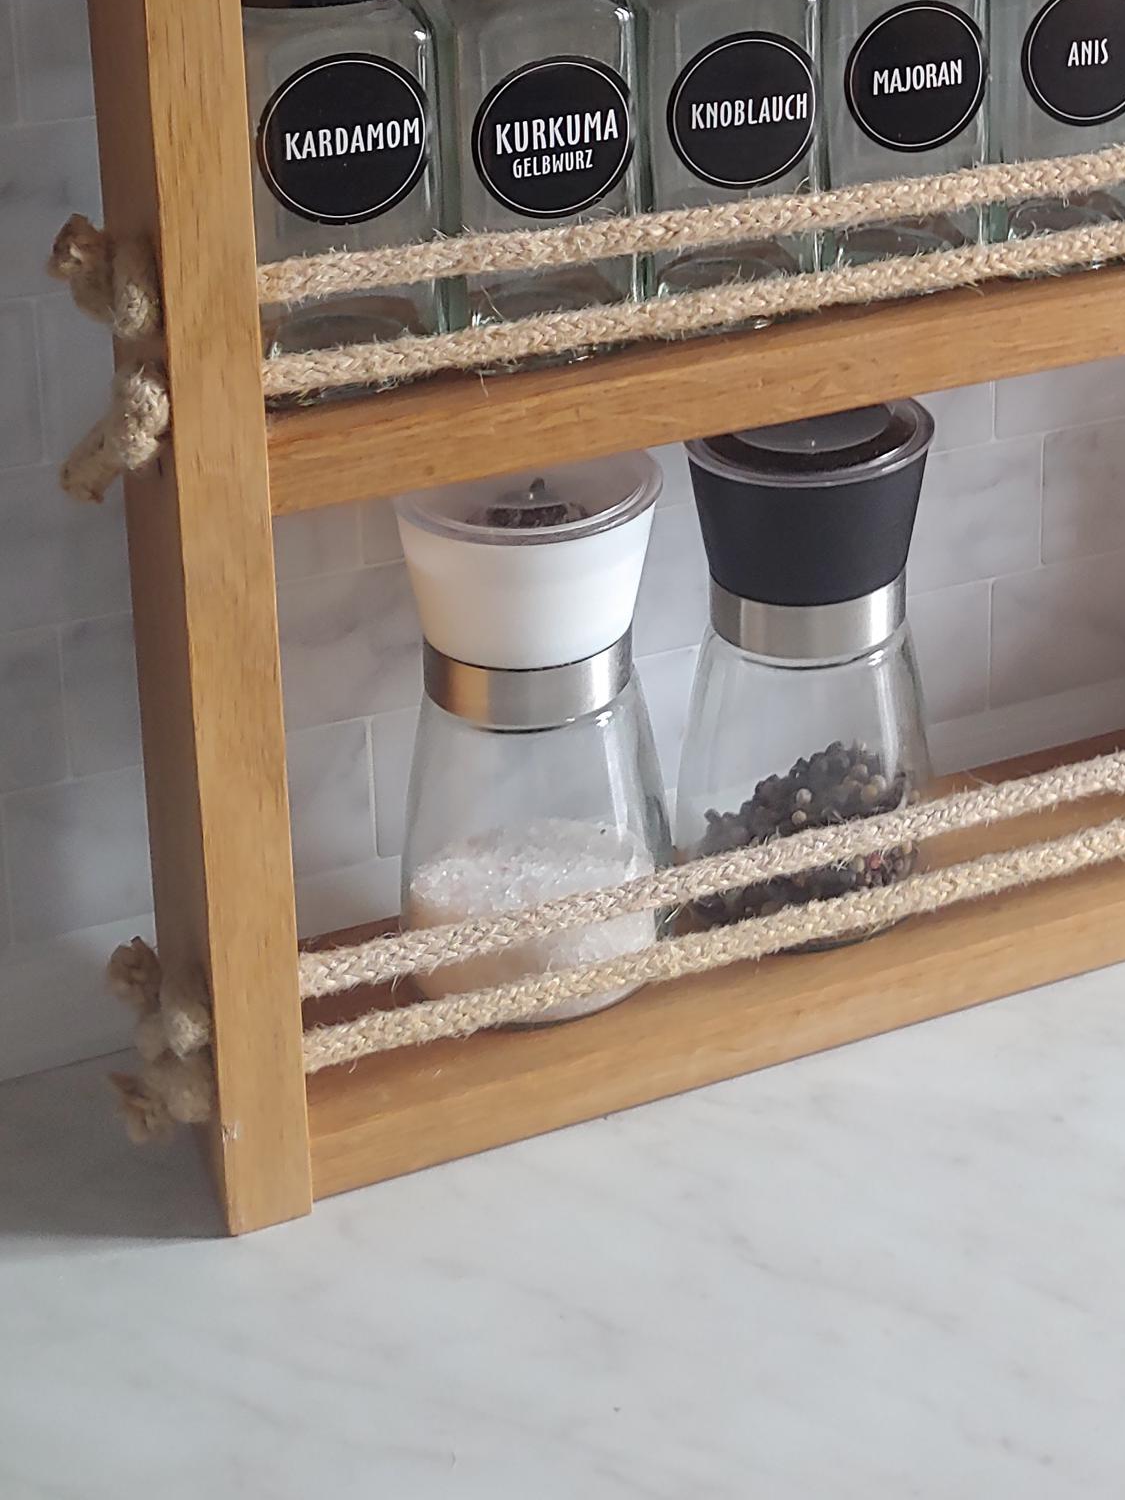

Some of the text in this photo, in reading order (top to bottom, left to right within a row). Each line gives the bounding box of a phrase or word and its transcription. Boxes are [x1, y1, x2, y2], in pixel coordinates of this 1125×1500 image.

[1067, 38, 1109, 68] ANIS
[872, 59, 963, 96] MAJORAN
[691, 92, 809, 131] KNOBLAUCH
[284, 117, 421, 161] KARDAMOM
[495, 109, 619, 156] KURKUMA
[513, 149, 593, 179] GELBWURZ
